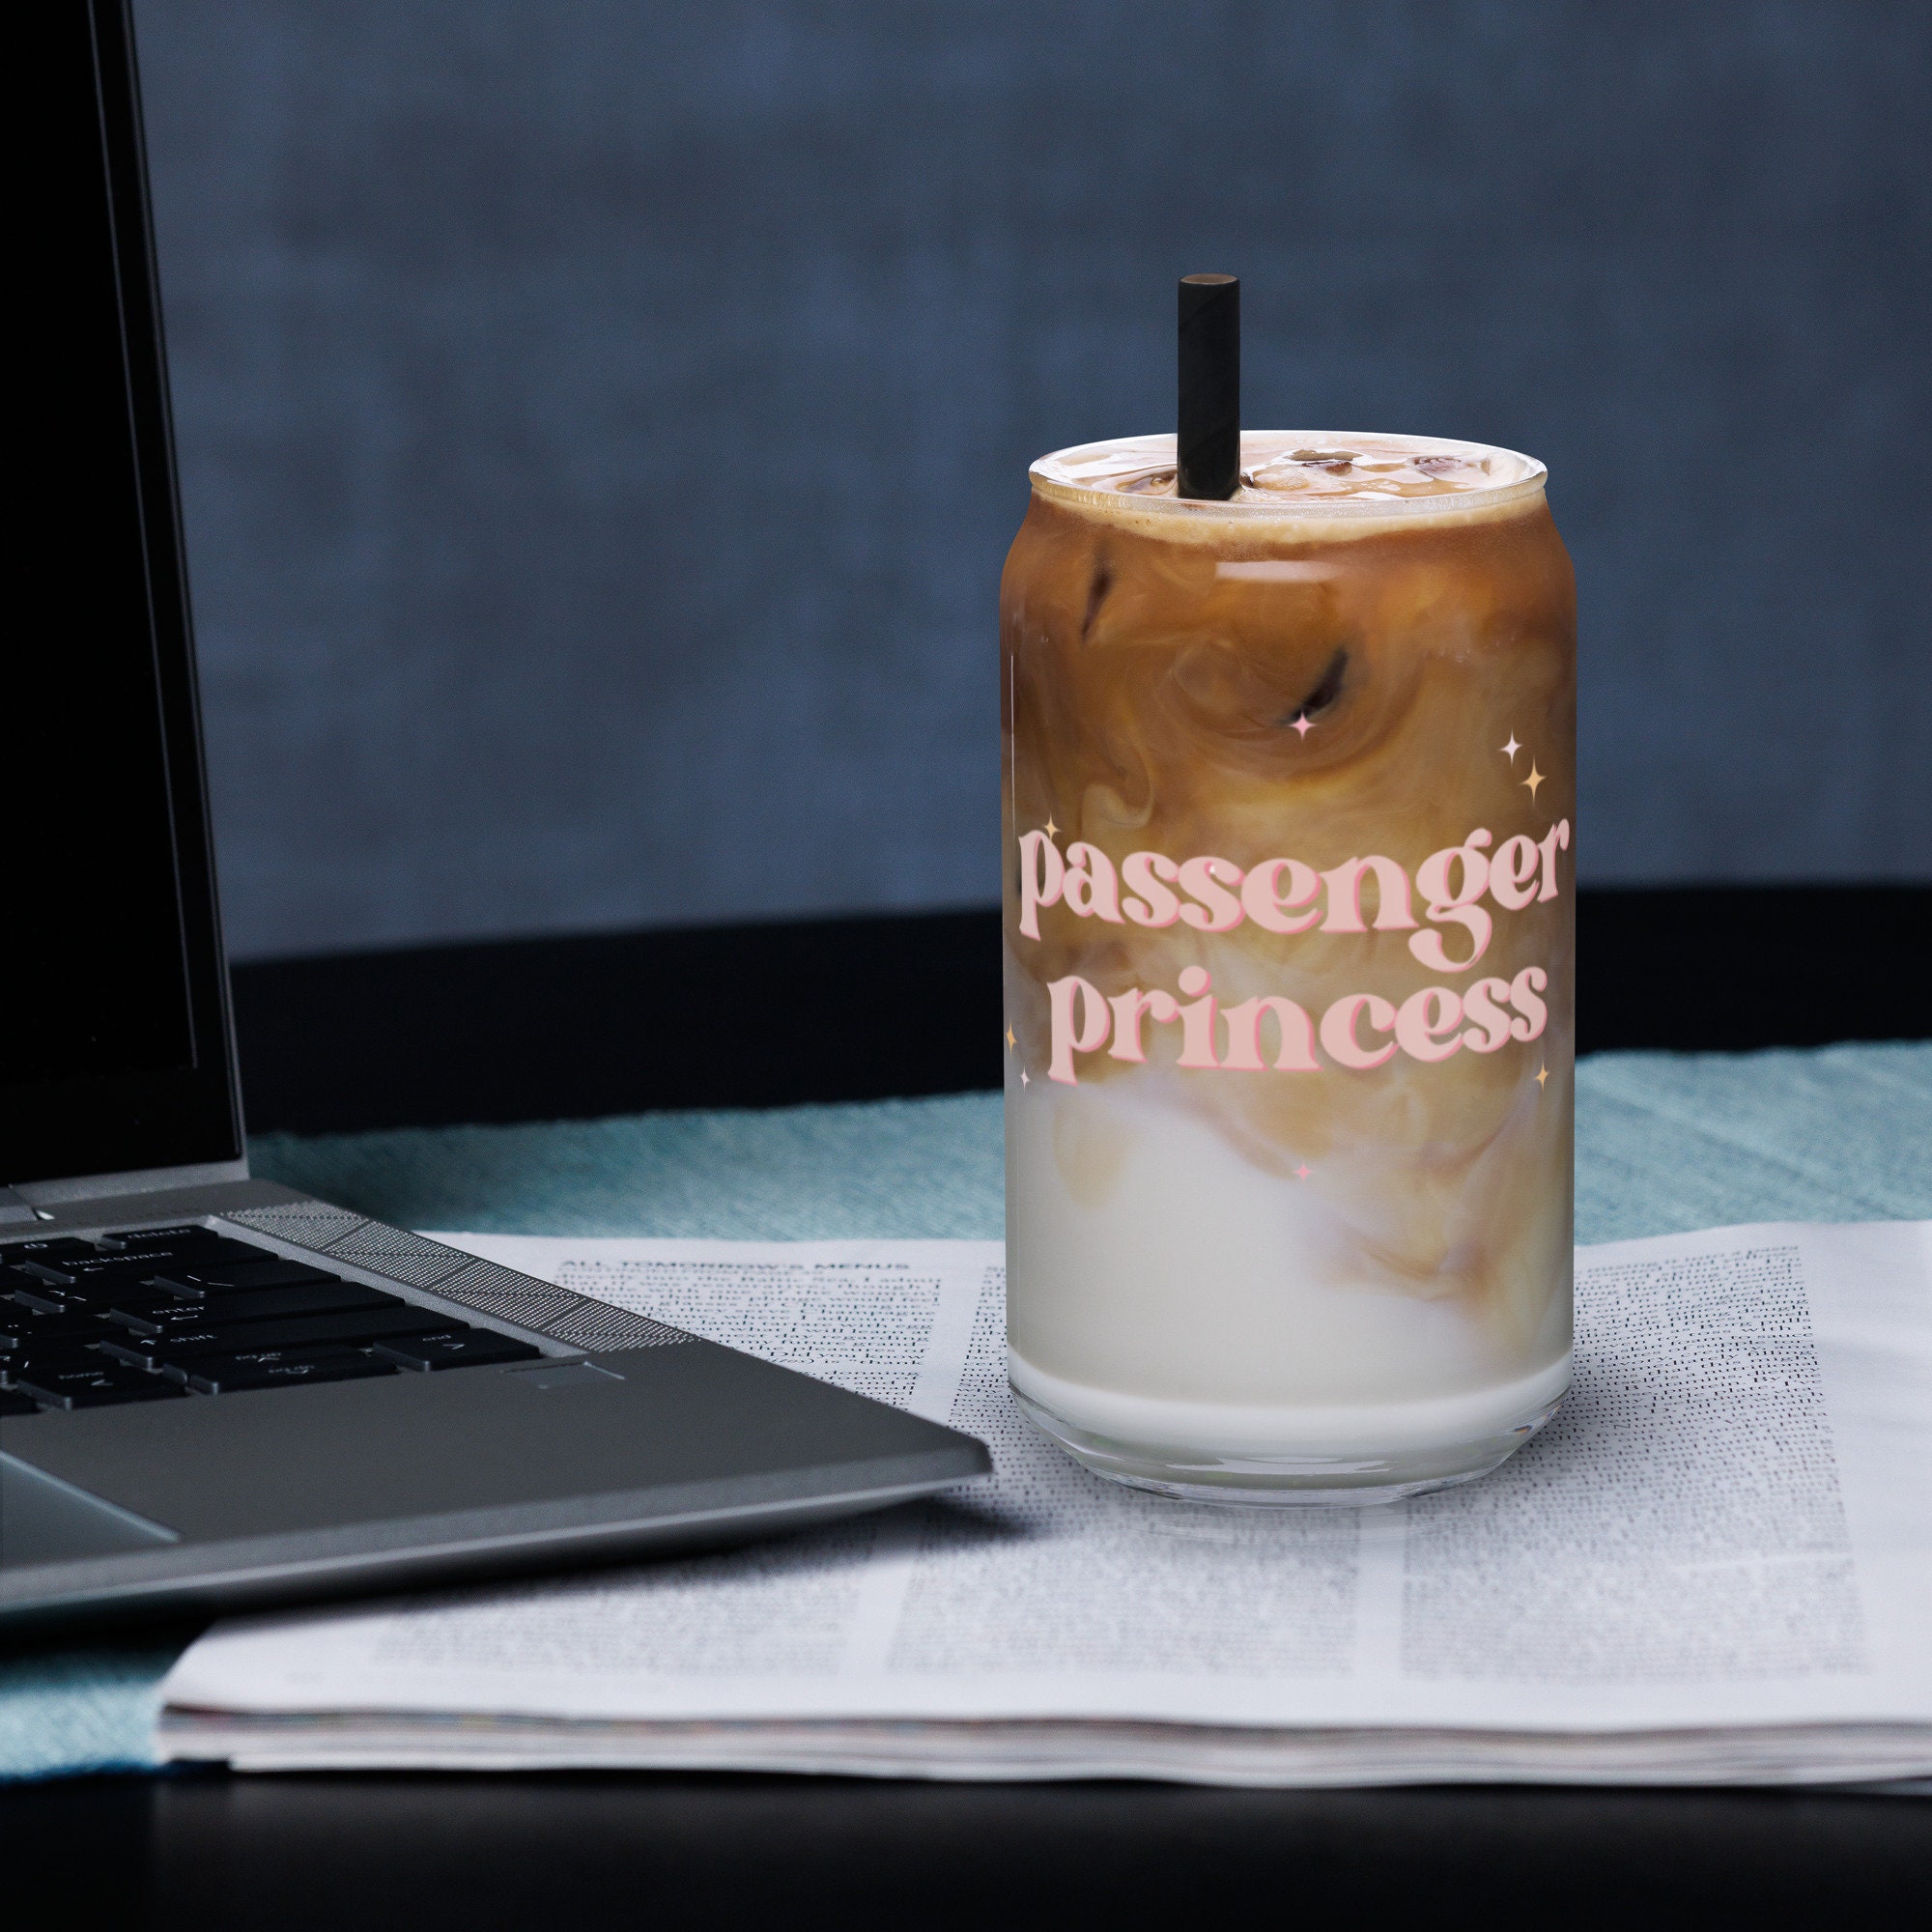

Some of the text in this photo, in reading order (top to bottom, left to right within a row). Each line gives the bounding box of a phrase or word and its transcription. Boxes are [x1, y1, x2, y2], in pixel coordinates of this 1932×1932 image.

[1017, 818, 1571, 973] passenger
[1046, 965, 1548, 1085] princess
[127, 1228, 190, 1240] delete
[62, 1252, 174, 1266] backspace
[152, 1305, 206, 1315] enter
[169, 1334, 217, 1343] shift
[421, 1334, 452, 1343] end
